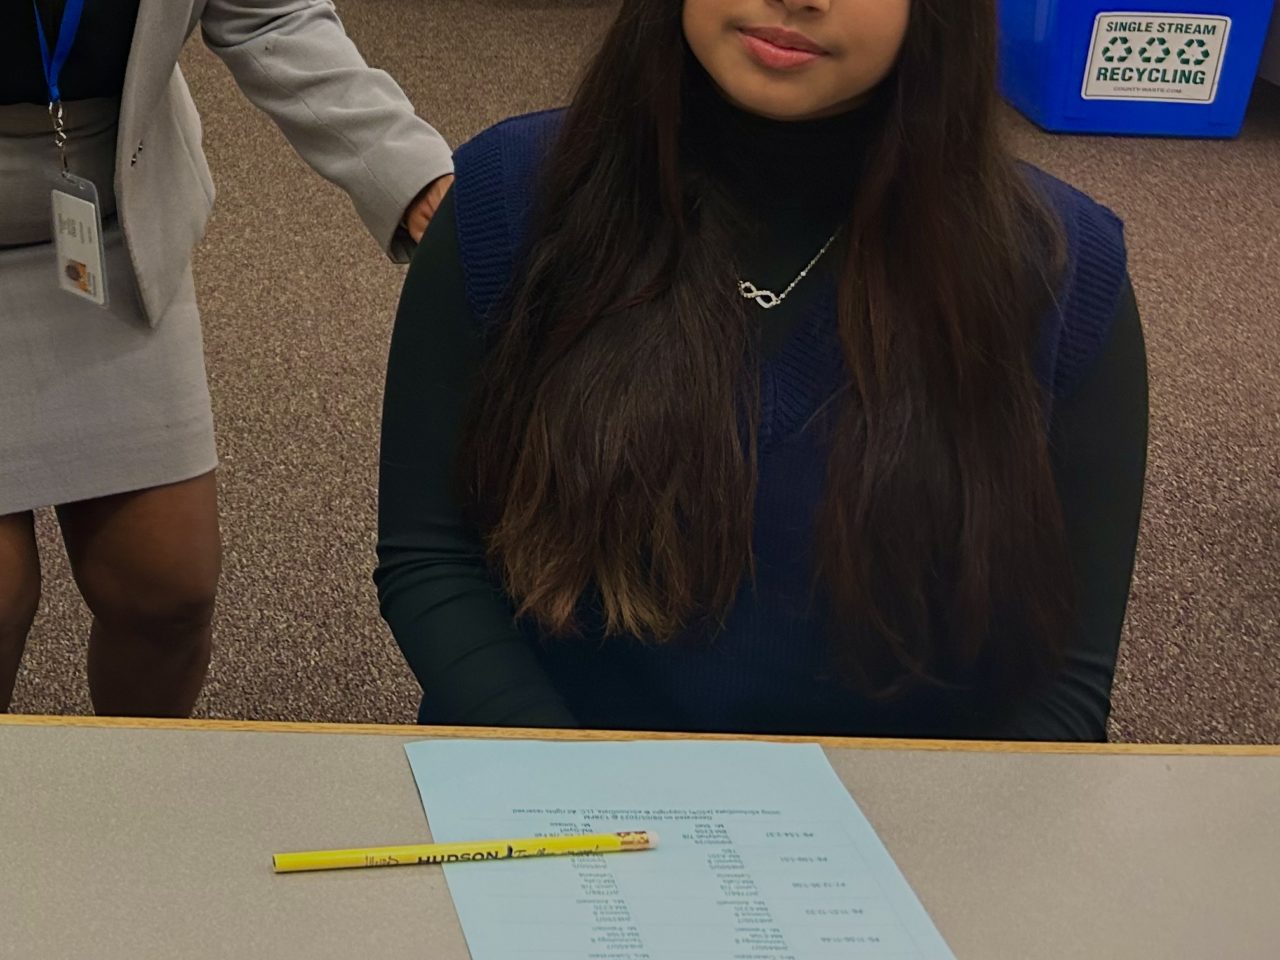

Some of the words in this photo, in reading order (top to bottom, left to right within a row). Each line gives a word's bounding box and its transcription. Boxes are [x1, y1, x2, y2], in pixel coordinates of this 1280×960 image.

[1106, 21, 1154, 33] SINGLE
[1157, 22, 1217, 35] STREAM
[1096, 67, 1206, 85] RECYCLING
